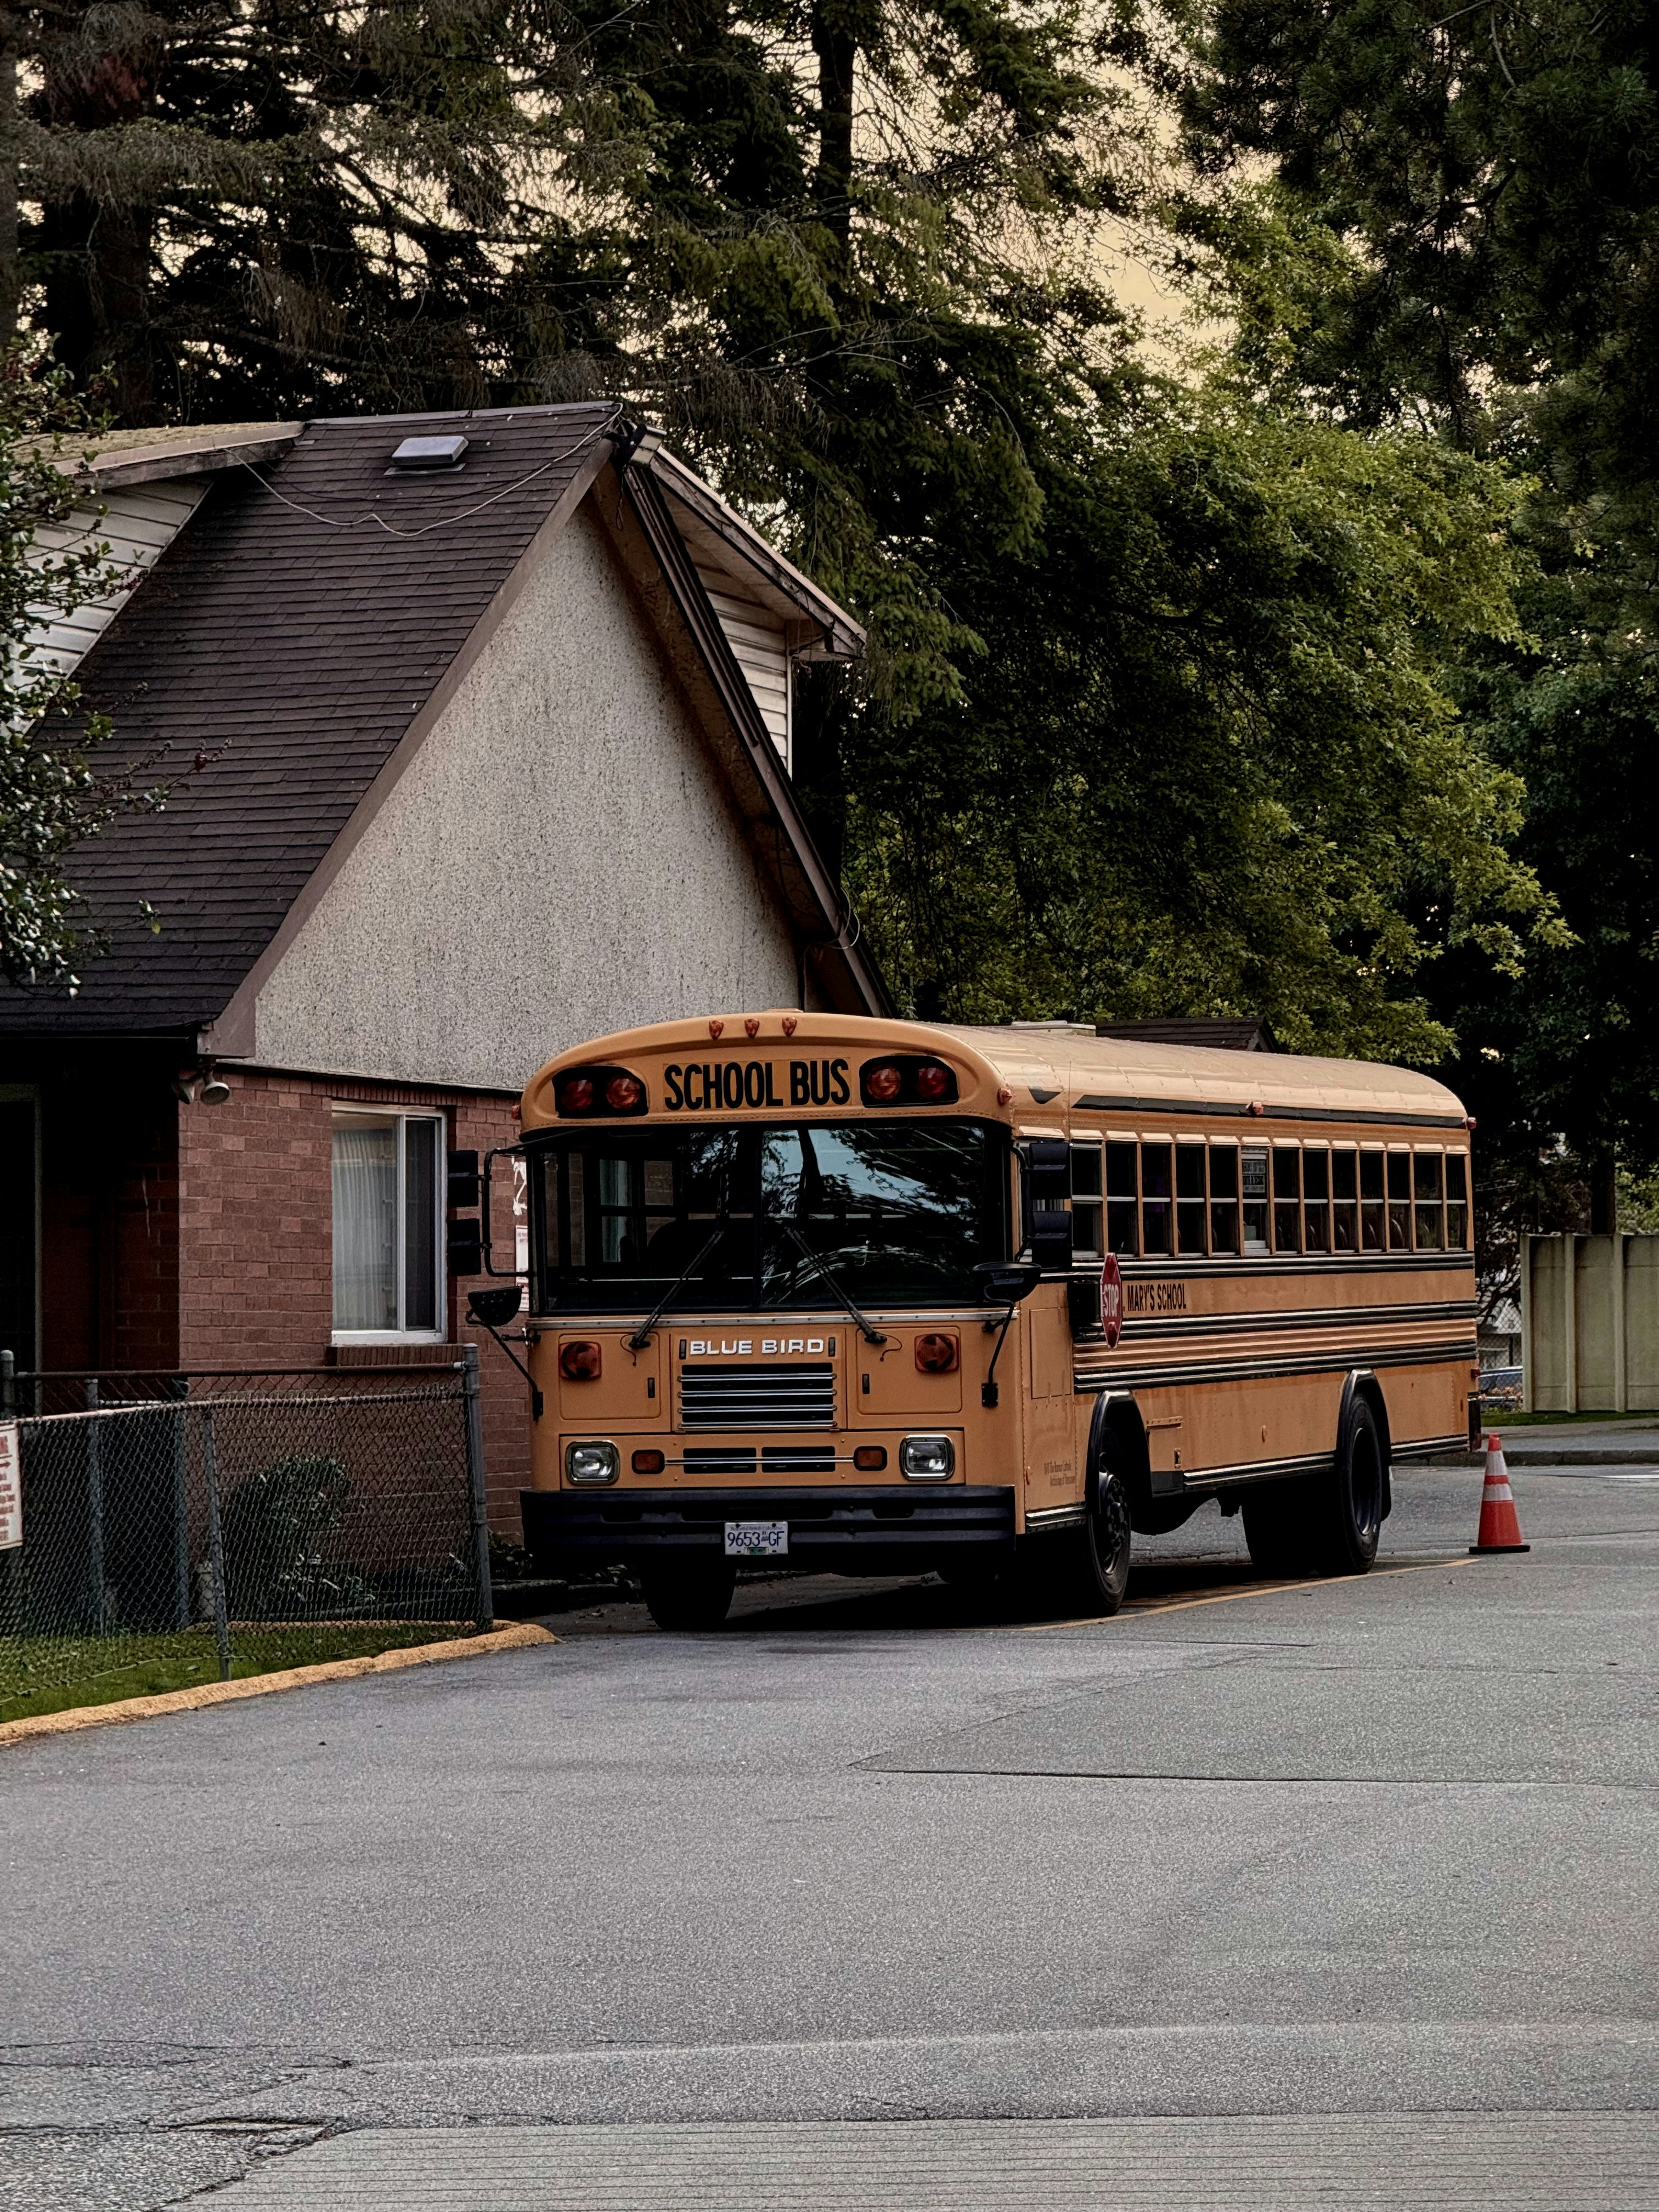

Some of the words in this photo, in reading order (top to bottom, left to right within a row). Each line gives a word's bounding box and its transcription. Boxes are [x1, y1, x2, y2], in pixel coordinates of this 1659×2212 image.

[664, 1062, 783, 1110] SCHOOL
[790, 1059, 850, 1105] BUS
[1104, 1283, 1119, 1317] STOP
[1127, 1284, 1155, 1311] MARY'S
[1157, 1283, 1187, 1310] SCHOOL
[690, 1340, 752, 1355] BLUE
[761, 1339, 824, 1354] BIRD
[727, 1532, 760, 1547] 9653
[768, 1531, 785, 1547] GF
